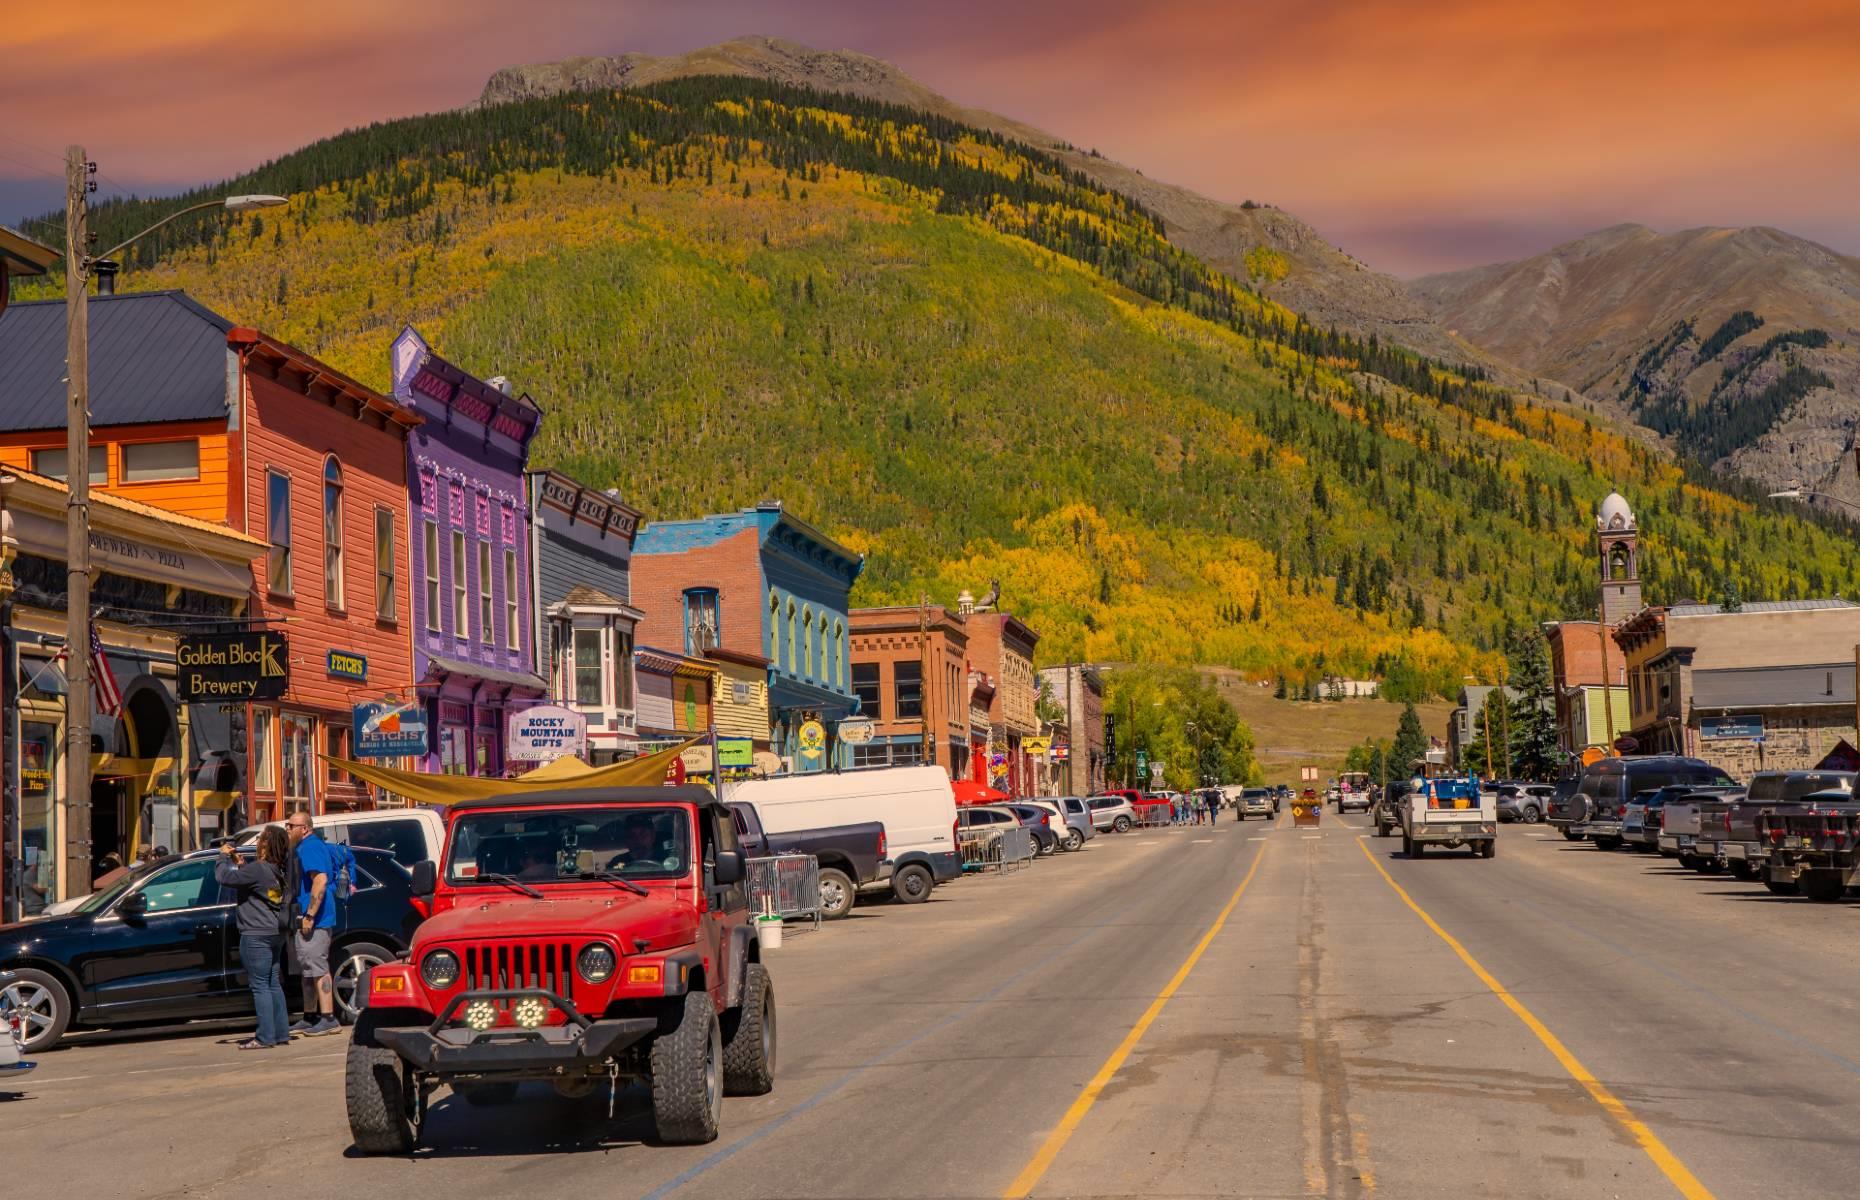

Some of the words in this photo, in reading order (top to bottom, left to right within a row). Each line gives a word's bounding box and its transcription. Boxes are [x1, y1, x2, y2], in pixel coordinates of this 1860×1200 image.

[89, 533, 139, 559] BREWERY
[159, 551, 185, 570] PIZZA
[177, 643, 226, 666] Golden
[331, 654, 363, 675] FETCH'S
[191, 674, 258, 697] Brewery
[521, 728, 576, 737] MOUNTAIN
[529, 718, 565, 727] ROCKY
[532, 738, 562, 747] GIFTS
